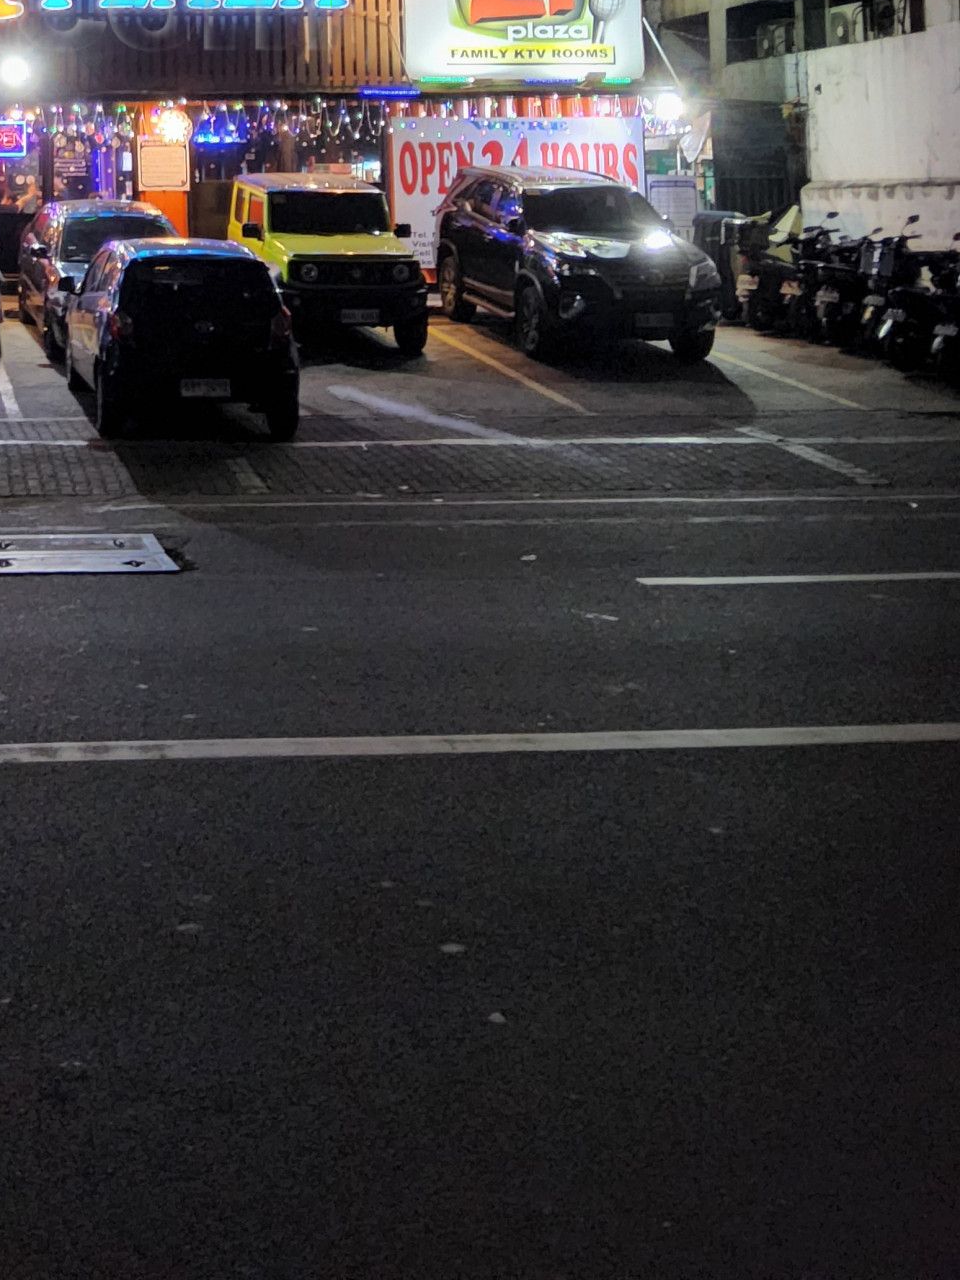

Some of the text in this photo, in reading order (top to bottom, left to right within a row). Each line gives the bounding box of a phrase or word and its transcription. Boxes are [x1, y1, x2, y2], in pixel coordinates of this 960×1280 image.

[507, 22, 590, 42] plaza
[450, 48, 609, 60] FAMILY KTV ROOMS
[399, 141, 475, 196] OPEN
